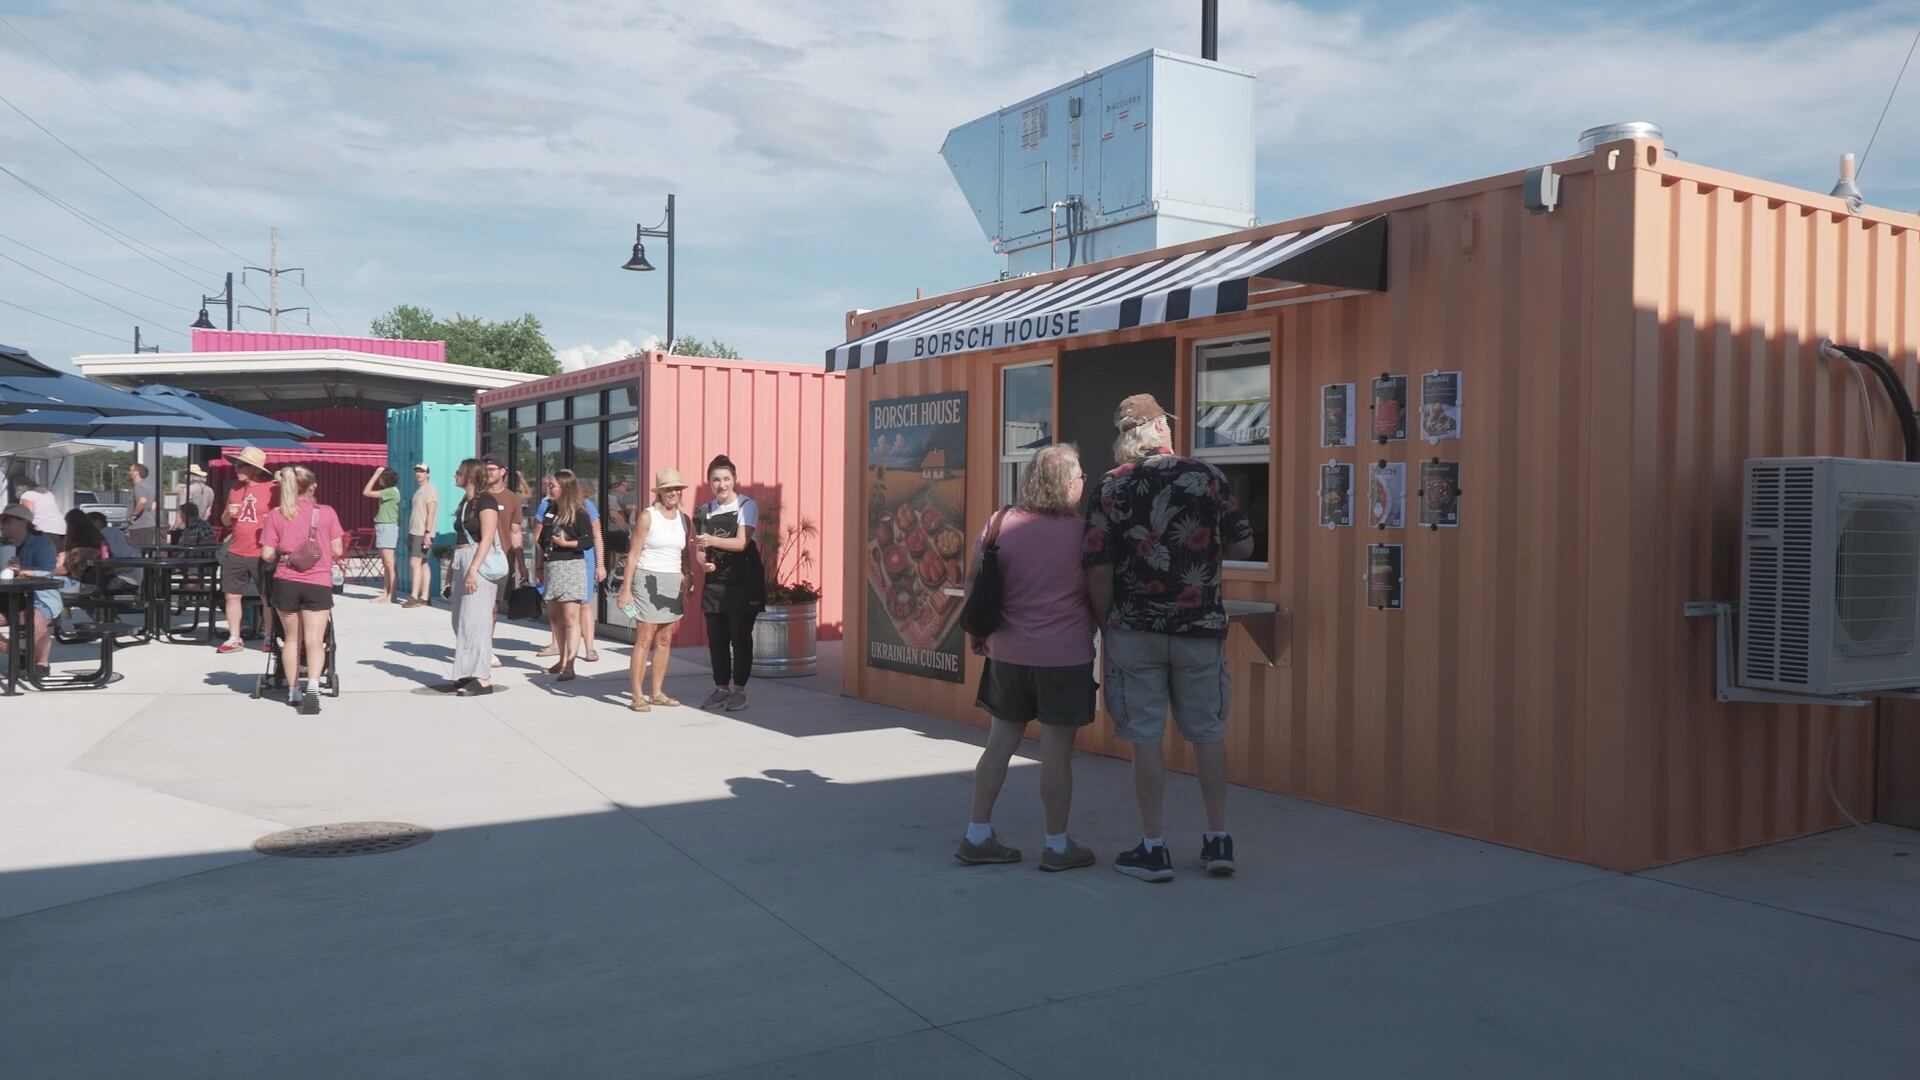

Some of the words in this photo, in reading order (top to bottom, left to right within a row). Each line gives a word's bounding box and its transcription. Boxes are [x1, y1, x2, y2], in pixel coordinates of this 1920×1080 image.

[914, 325, 993, 357] BORSCH
[1004, 310, 1080, 343] HOUSE
[874, 403, 918, 429] BORSCH
[921, 399, 961, 425] HOUSE
[238, 493, 258, 523] A
[871, 641, 918, 665] UKRAINIAN
[920, 649, 958, 672] CUISINE
